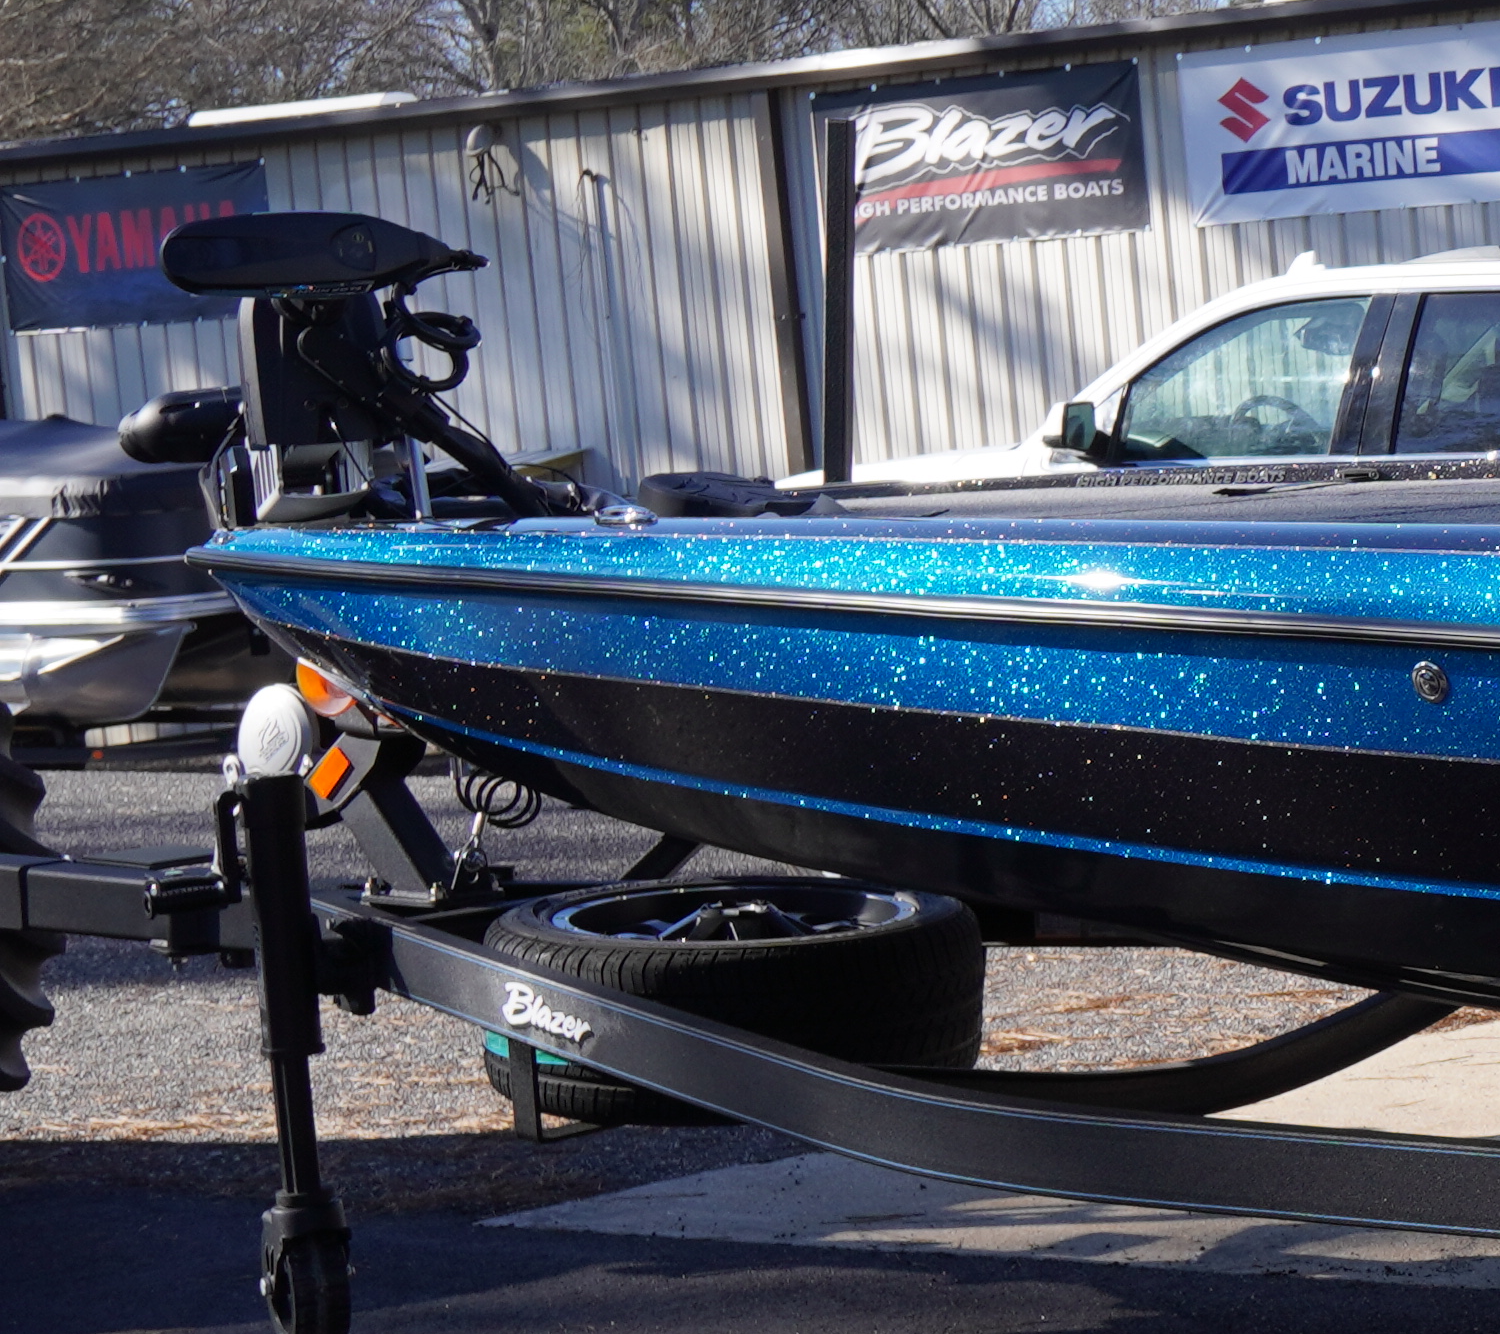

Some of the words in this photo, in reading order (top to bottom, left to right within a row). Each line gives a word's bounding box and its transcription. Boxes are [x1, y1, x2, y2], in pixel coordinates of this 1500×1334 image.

[855, 105, 1116, 185] Blazer
[1285, 137, 1441, 185] MARINE
[897, 184, 1049, 215] PERFORMANCE
[1054, 178, 1124, 201] BOATS
[1075, 475, 1117, 487] HIGH
[1119, 471, 1234, 487] PERFORMANCE
[1234, 469, 1286, 485] BOATS
[501, 980, 594, 1044] Blazer
